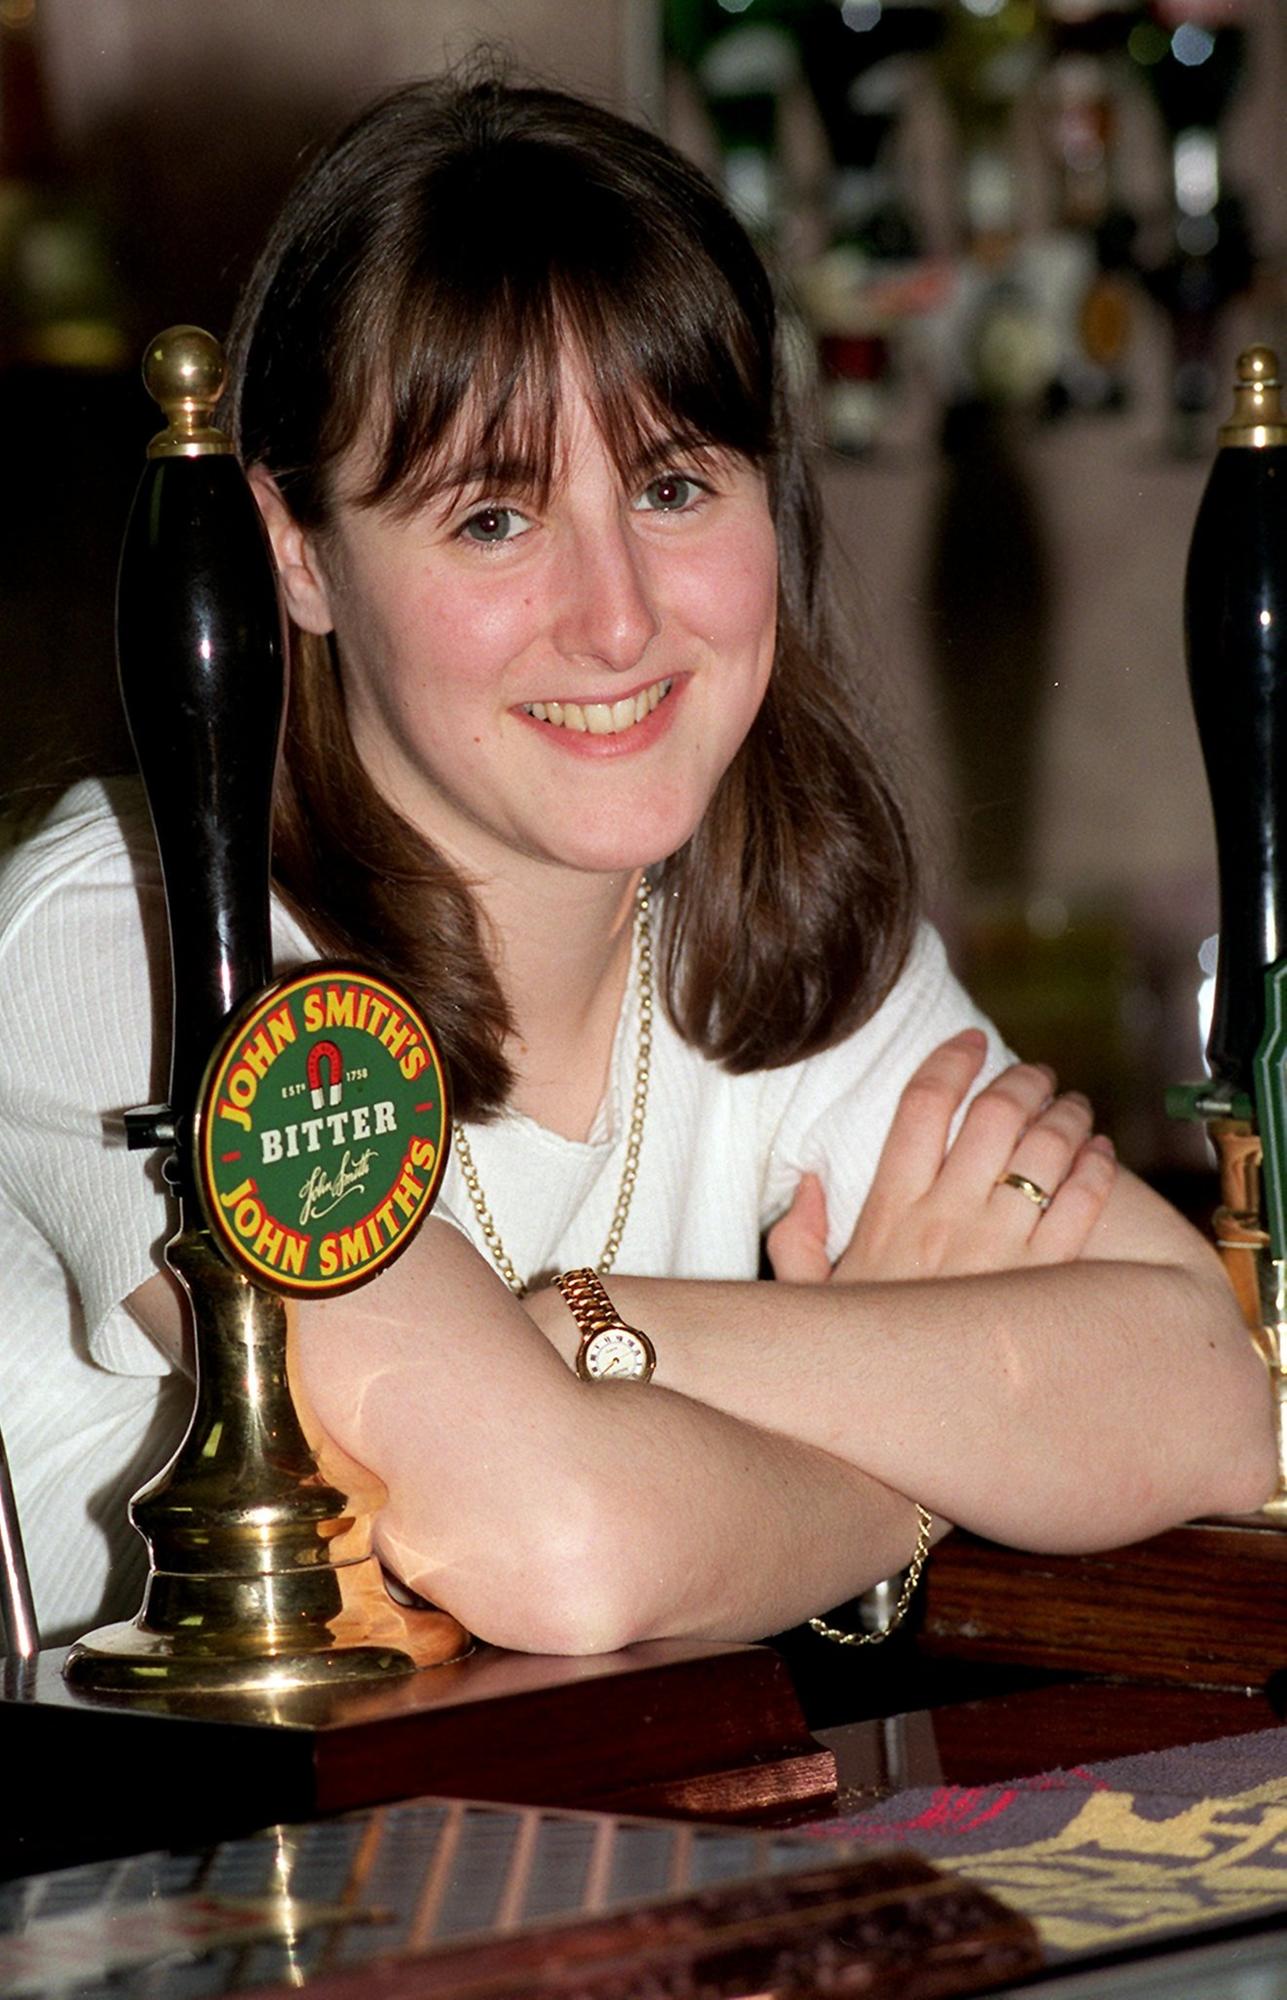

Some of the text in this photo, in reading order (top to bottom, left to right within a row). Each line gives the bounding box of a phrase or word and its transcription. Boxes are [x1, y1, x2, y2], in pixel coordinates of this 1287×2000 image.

[217, 984, 430, 1132] JOHN SMITH'S
[345, 1067, 368, 1082] 1758
[260, 1101, 397, 1165] BITTER
[220, 1135, 436, 1276] JOHN SMITH'S
